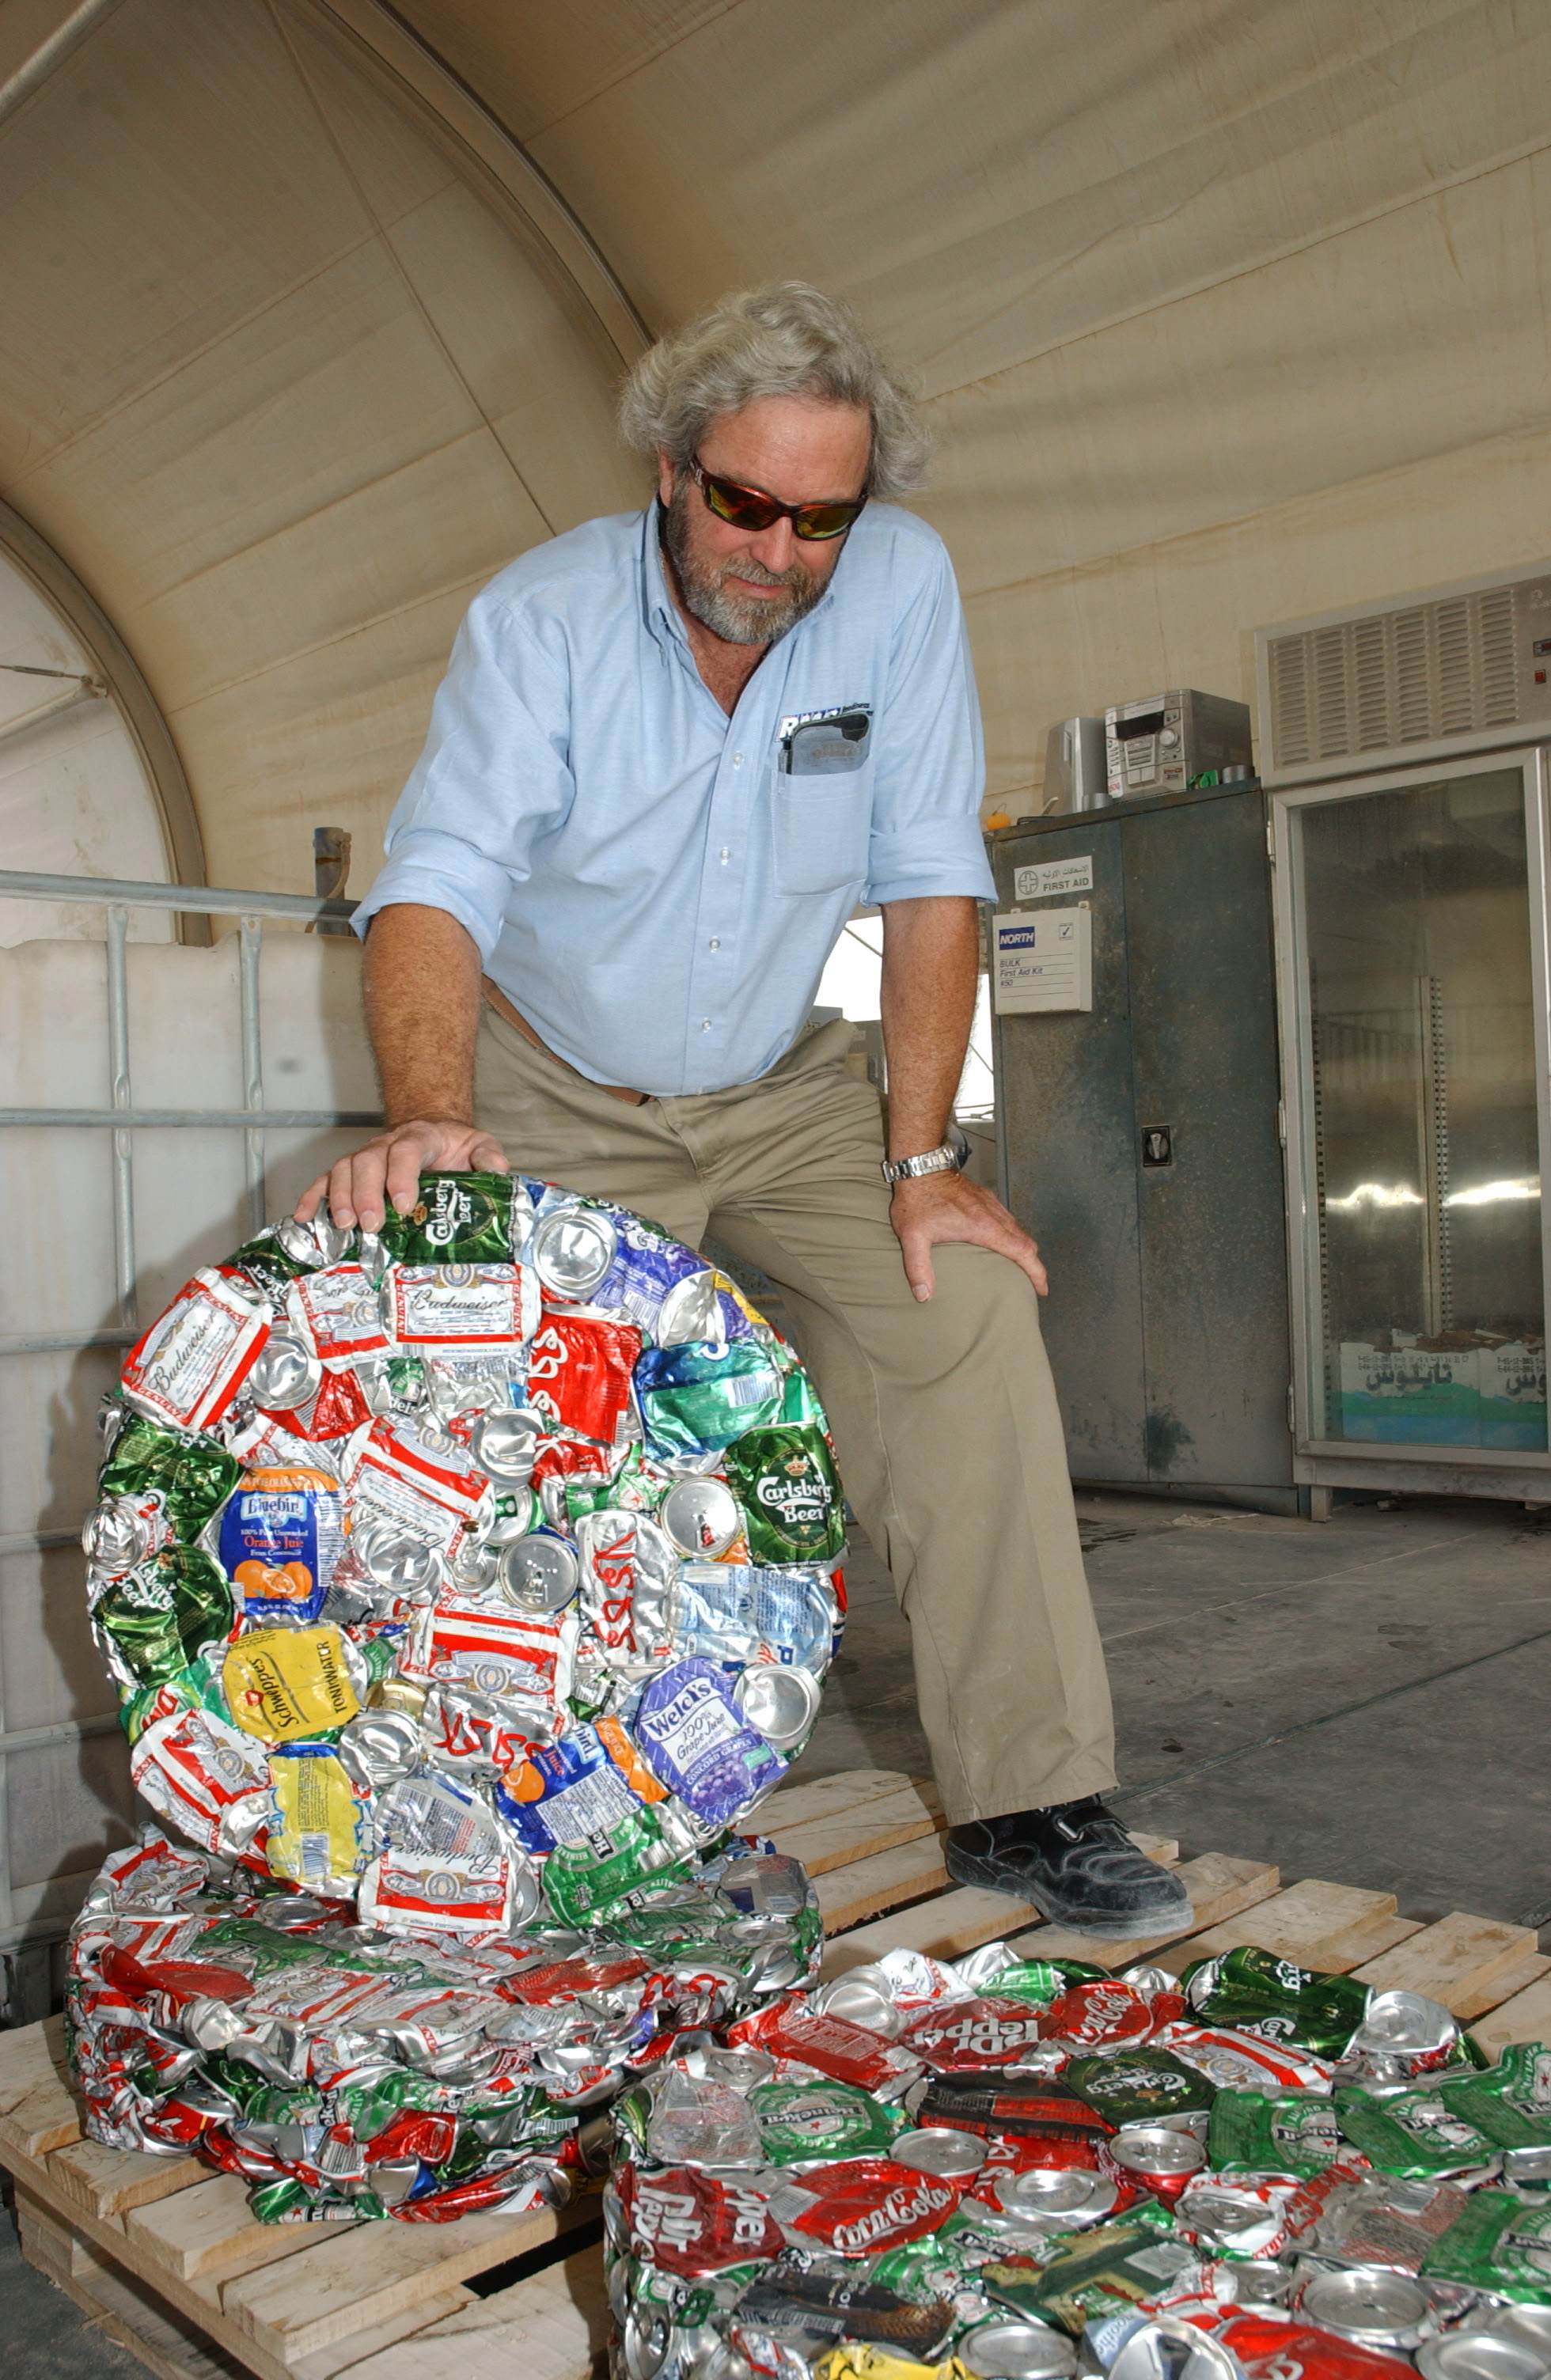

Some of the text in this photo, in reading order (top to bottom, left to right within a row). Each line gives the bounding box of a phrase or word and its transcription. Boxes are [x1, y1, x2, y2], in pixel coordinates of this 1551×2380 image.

[1043, 877, 1090, 892] FIRST AID
[999, 933, 1033, 945] NORTH
[999, 959, 1021, 968] BULK
[999, 968, 1017, 978] First
[1018, 968, 1030, 976] Aid
[426, 1179, 457, 1246] Calsberg
[407, 1288, 509, 1311] Budweiser
[147, 1309, 217, 1393] Budweiser
[136, 1385, 188, 1423] GENUINE
[757, 1476, 833, 1507] Carlsberg
[355, 1492, 446, 1548] Budweiser
[784, 1506, 825, 1523] Beer
[250, 1657, 299, 1730] Schweppes
[681, 1711, 711, 1742] 100%
[677, 1732, 707, 1760] Grape
[544, 1749, 566, 1776] Juice
[685, 1754, 721, 1787] CONCORD
[953, 2036, 1003, 2055] Dr
[722, 2181, 767, 2246] pper
[833, 2180, 953, 2250] Coca-Cola
